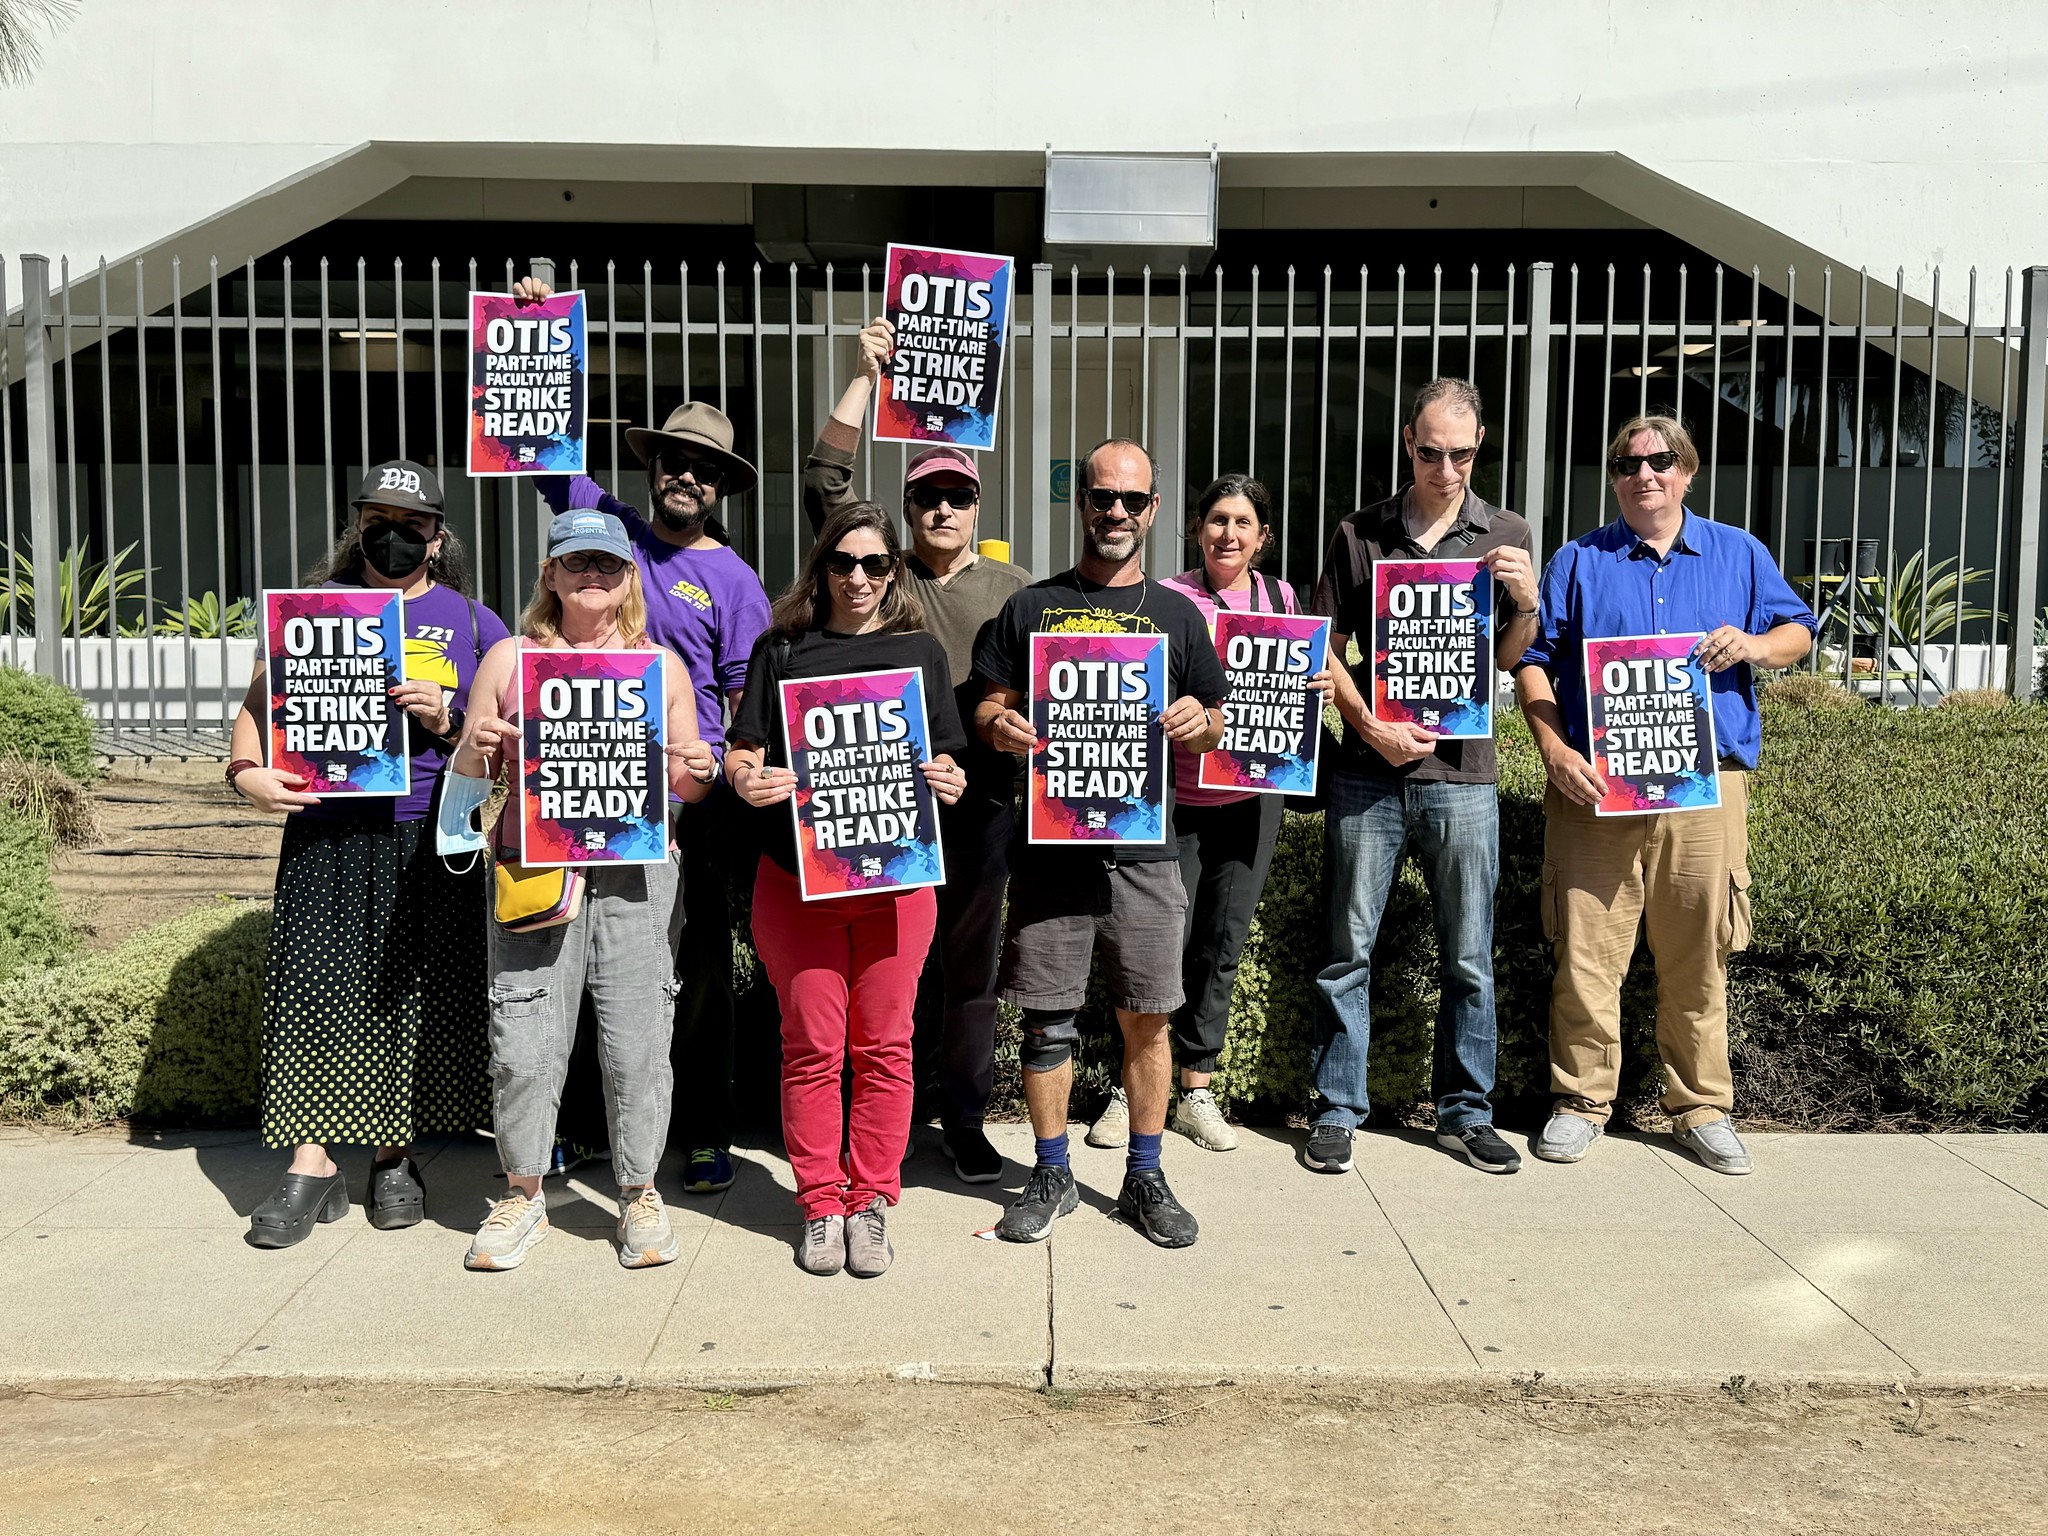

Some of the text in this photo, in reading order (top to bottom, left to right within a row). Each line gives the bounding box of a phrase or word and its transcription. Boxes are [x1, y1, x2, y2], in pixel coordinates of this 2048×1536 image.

[901, 274, 991, 319] OTIS
[487, 318, 572, 354] OTIS
[898, 313, 988, 339] PART-TIME
[896, 334, 987, 355] FACULTY ARE
[486, 354, 571, 370] PART-TIME
[894, 350, 985, 381] STRIKE
[486, 372, 571, 386] FACULTY ARE
[892, 375, 984, 408] READY
[485, 386, 571, 410] STRIKE
[484, 411, 572, 436] READY
[571, 528, 610, 536] ARGENTINA
[669, 589, 706, 612] LOCAL 721
[673, 581, 712, 607] SEIU
[1389, 583, 1475, 618] OTIS
[284, 617, 383, 656] OTIS
[416, 626, 454, 641] 721
[1388, 619, 1475, 635] PART-TIME
[1227, 636, 1310, 672] OTIS
[1388, 636, 1475, 650] FACULTY ARE
[285, 658, 384, 676] PART-TIME
[1388, 651, 1475, 673] STRIKE
[286, 679, 385, 693] FACULTY ARE
[1049, 661, 1148, 701] OTIS
[1387, 676, 1476, 699] READY
[1602, 658, 1691, 694] OTIS
[286, 696, 386, 721] STRIKE
[540, 678, 645, 719] OTIS
[1223, 689, 1305, 705] ACULTY ARE
[1603, 693, 1693, 712] PART-TIME
[804, 700, 907, 748] OTIS
[1049, 703, 1147, 721] PART-TIME
[1221, 703, 1305, 729] STRIKE
[1605, 710, 1694, 726] FACULTY ARE
[287, 724, 388, 751] READY
[540, 722, 646, 740] PART-TIME
[1048, 724, 1147, 739] FACULTY ARE
[1218, 727, 1303, 755] READY
[1606, 725, 1697, 750] STRIKE
[540, 743, 646, 758] FACULTY ARE
[807, 742, 911, 770] PART-TIME
[1047, 742, 1147, 767] STRIKE
[1607, 748, 1699, 777] READY
[540, 761, 647, 787] STRIKE
[810, 763, 912, 788] FACULTY ARE
[1047, 770, 1148, 798] READY
[541, 790, 648, 819] READY
[812, 781, 916, 818] STRIKE
[814, 810, 918, 850] READY
